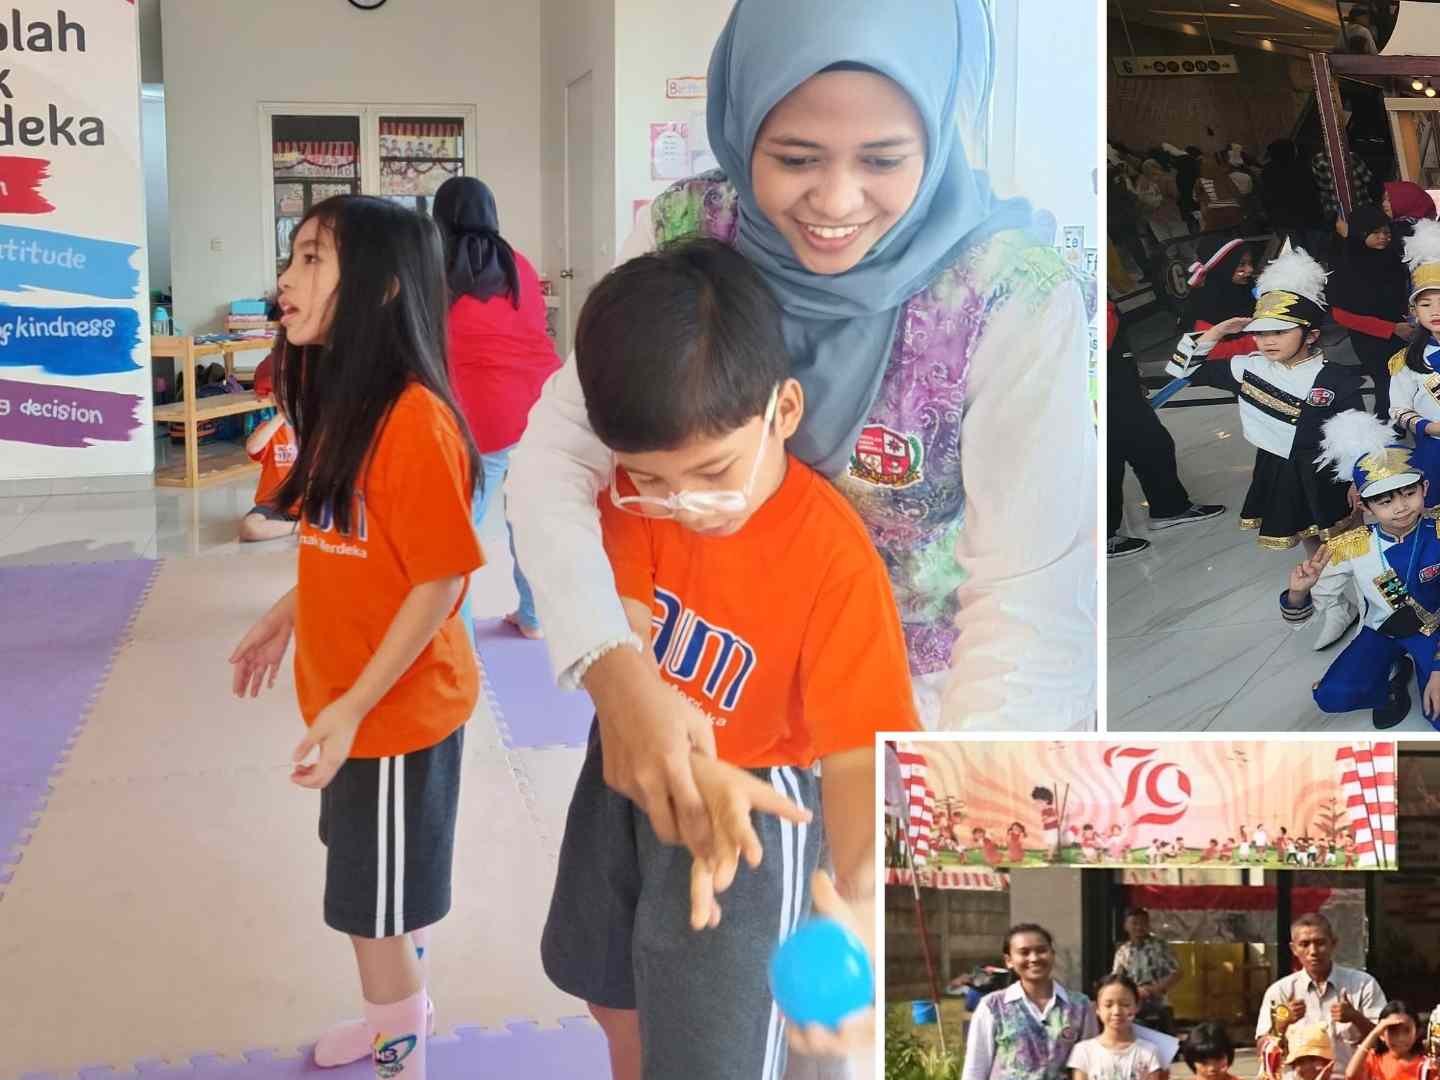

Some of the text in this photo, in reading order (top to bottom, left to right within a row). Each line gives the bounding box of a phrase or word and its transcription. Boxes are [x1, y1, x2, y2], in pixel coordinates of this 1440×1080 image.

[0, 239, 87, 269] titude
[15, 315, 115, 338] kindness
[19, 399, 104, 424] decision
[653, 585, 758, 713] AM
[1103, 745, 1192, 826] 79
